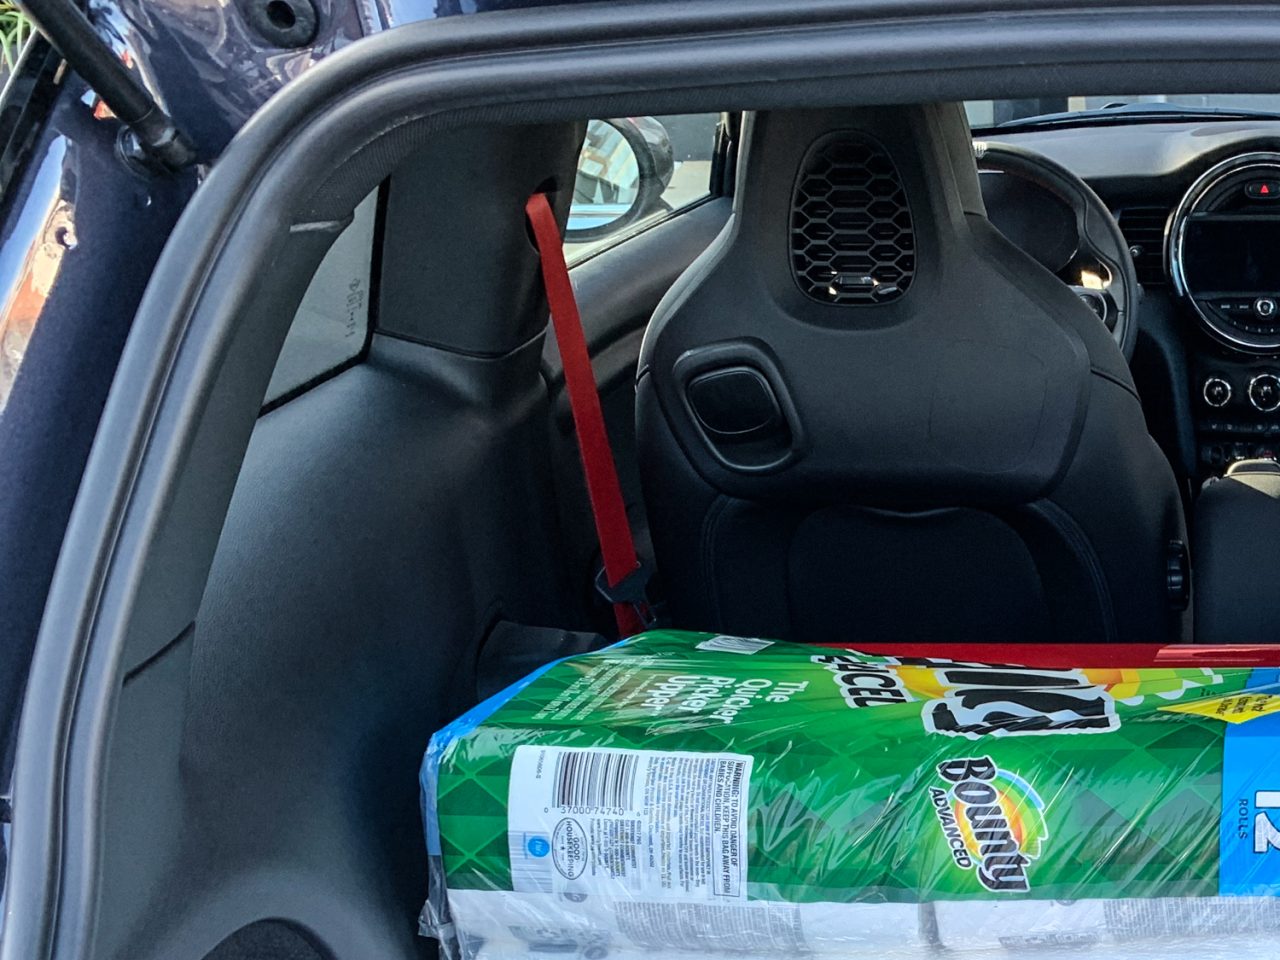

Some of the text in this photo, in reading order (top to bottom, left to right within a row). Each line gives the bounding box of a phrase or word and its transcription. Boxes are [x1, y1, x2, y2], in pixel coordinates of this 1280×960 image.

[641, 674, 702, 717] Upper
[678, 676, 736, 713] Picker
[709, 679, 772, 724] Quicker
[765, 681, 809, 703] The
[561, 806, 625, 816] 37000 74740
[713, 760, 727, 834] BABIES AND CHILDREN.
[730, 761, 744, 867] WARNING: TO AVOID DANGER OF
[1238, 799, 1248, 840] ROLLS
[566, 821, 575, 878] HOUSEKEEPING
[722, 805, 731, 894] KEEP THIS BAG AWAY FROM
[930, 787, 971, 869] ADVANCED
[938, 756, 1029, 892] Bounty
